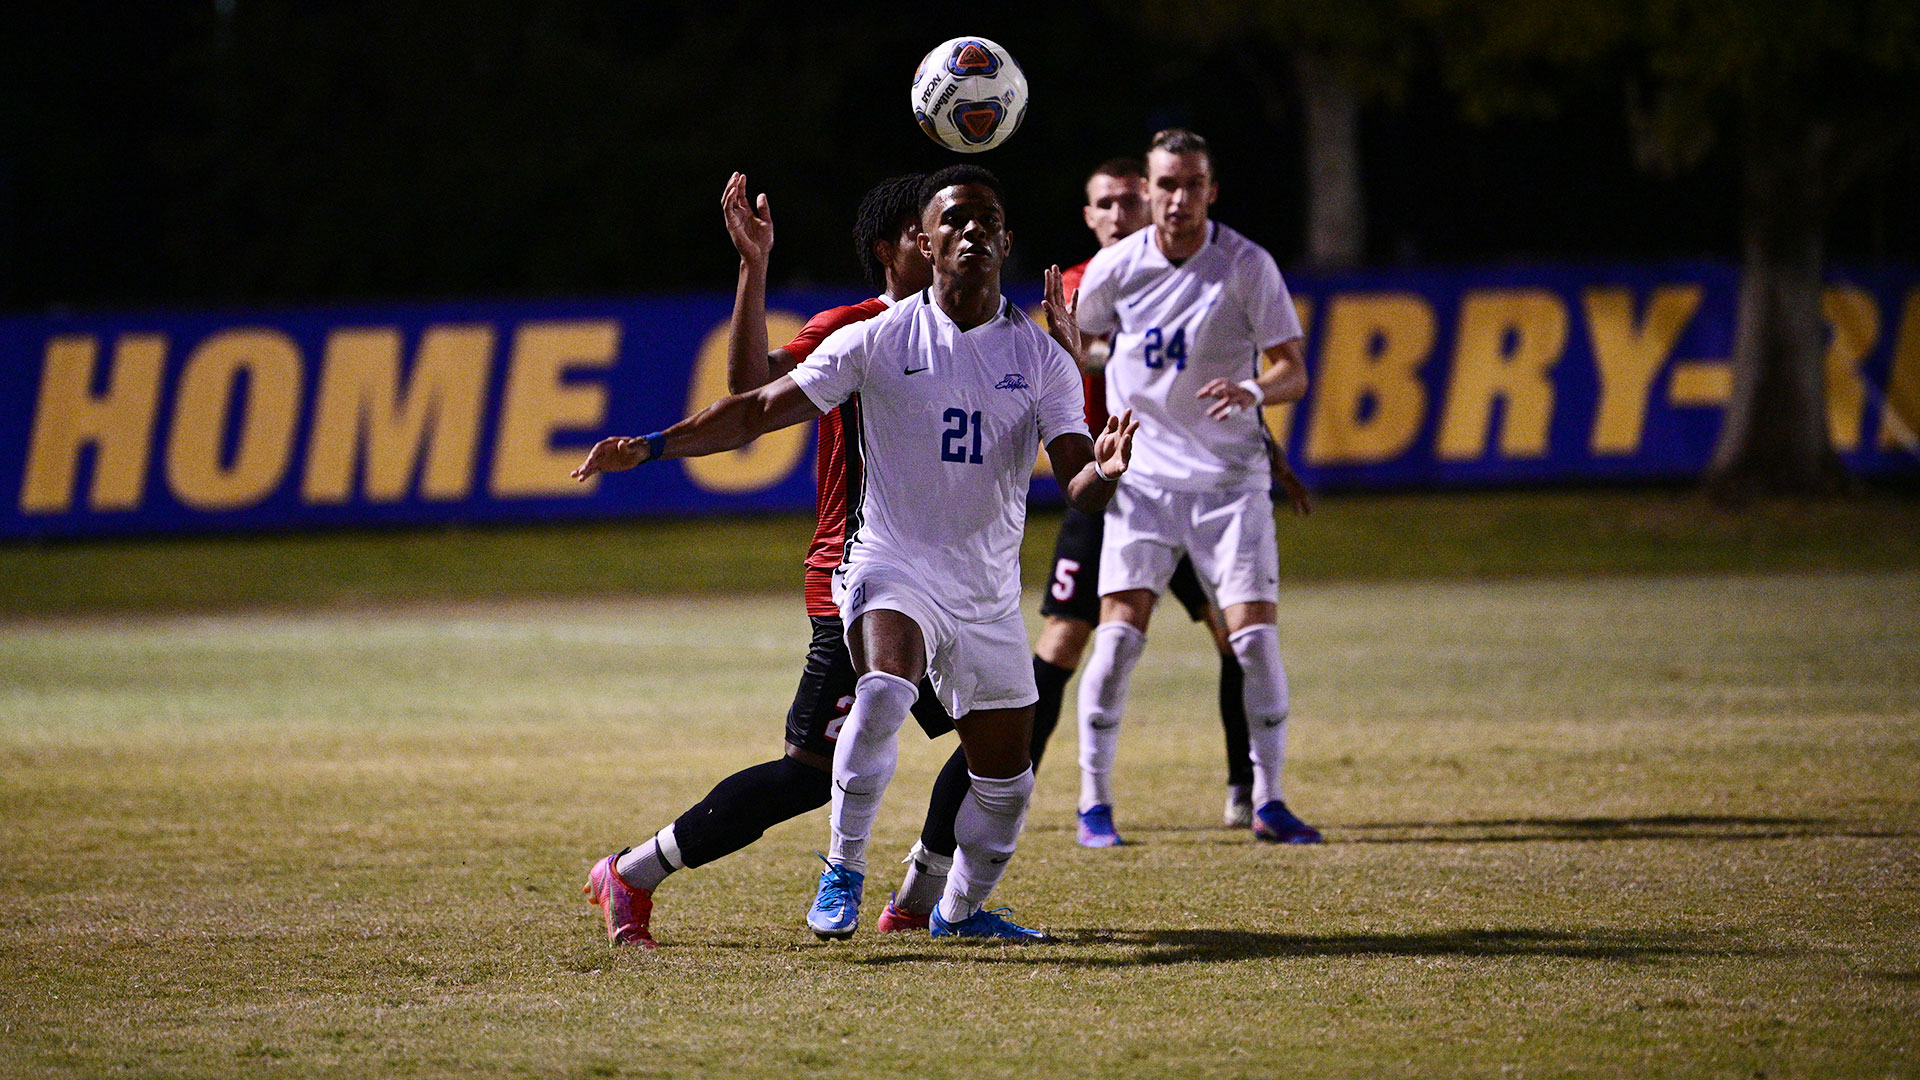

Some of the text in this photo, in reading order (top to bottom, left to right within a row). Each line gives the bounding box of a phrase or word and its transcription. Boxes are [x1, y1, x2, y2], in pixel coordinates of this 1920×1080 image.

[921, 73, 942, 104] NCAA
[931, 83, 959, 116] Wilson
[1144, 326, 1188, 370] 24
[19, 320, 622, 514] HOME
[941, 407, 983, 465] 21
[851, 582, 868, 612] 21
[1051, 557, 1080, 602] 5
